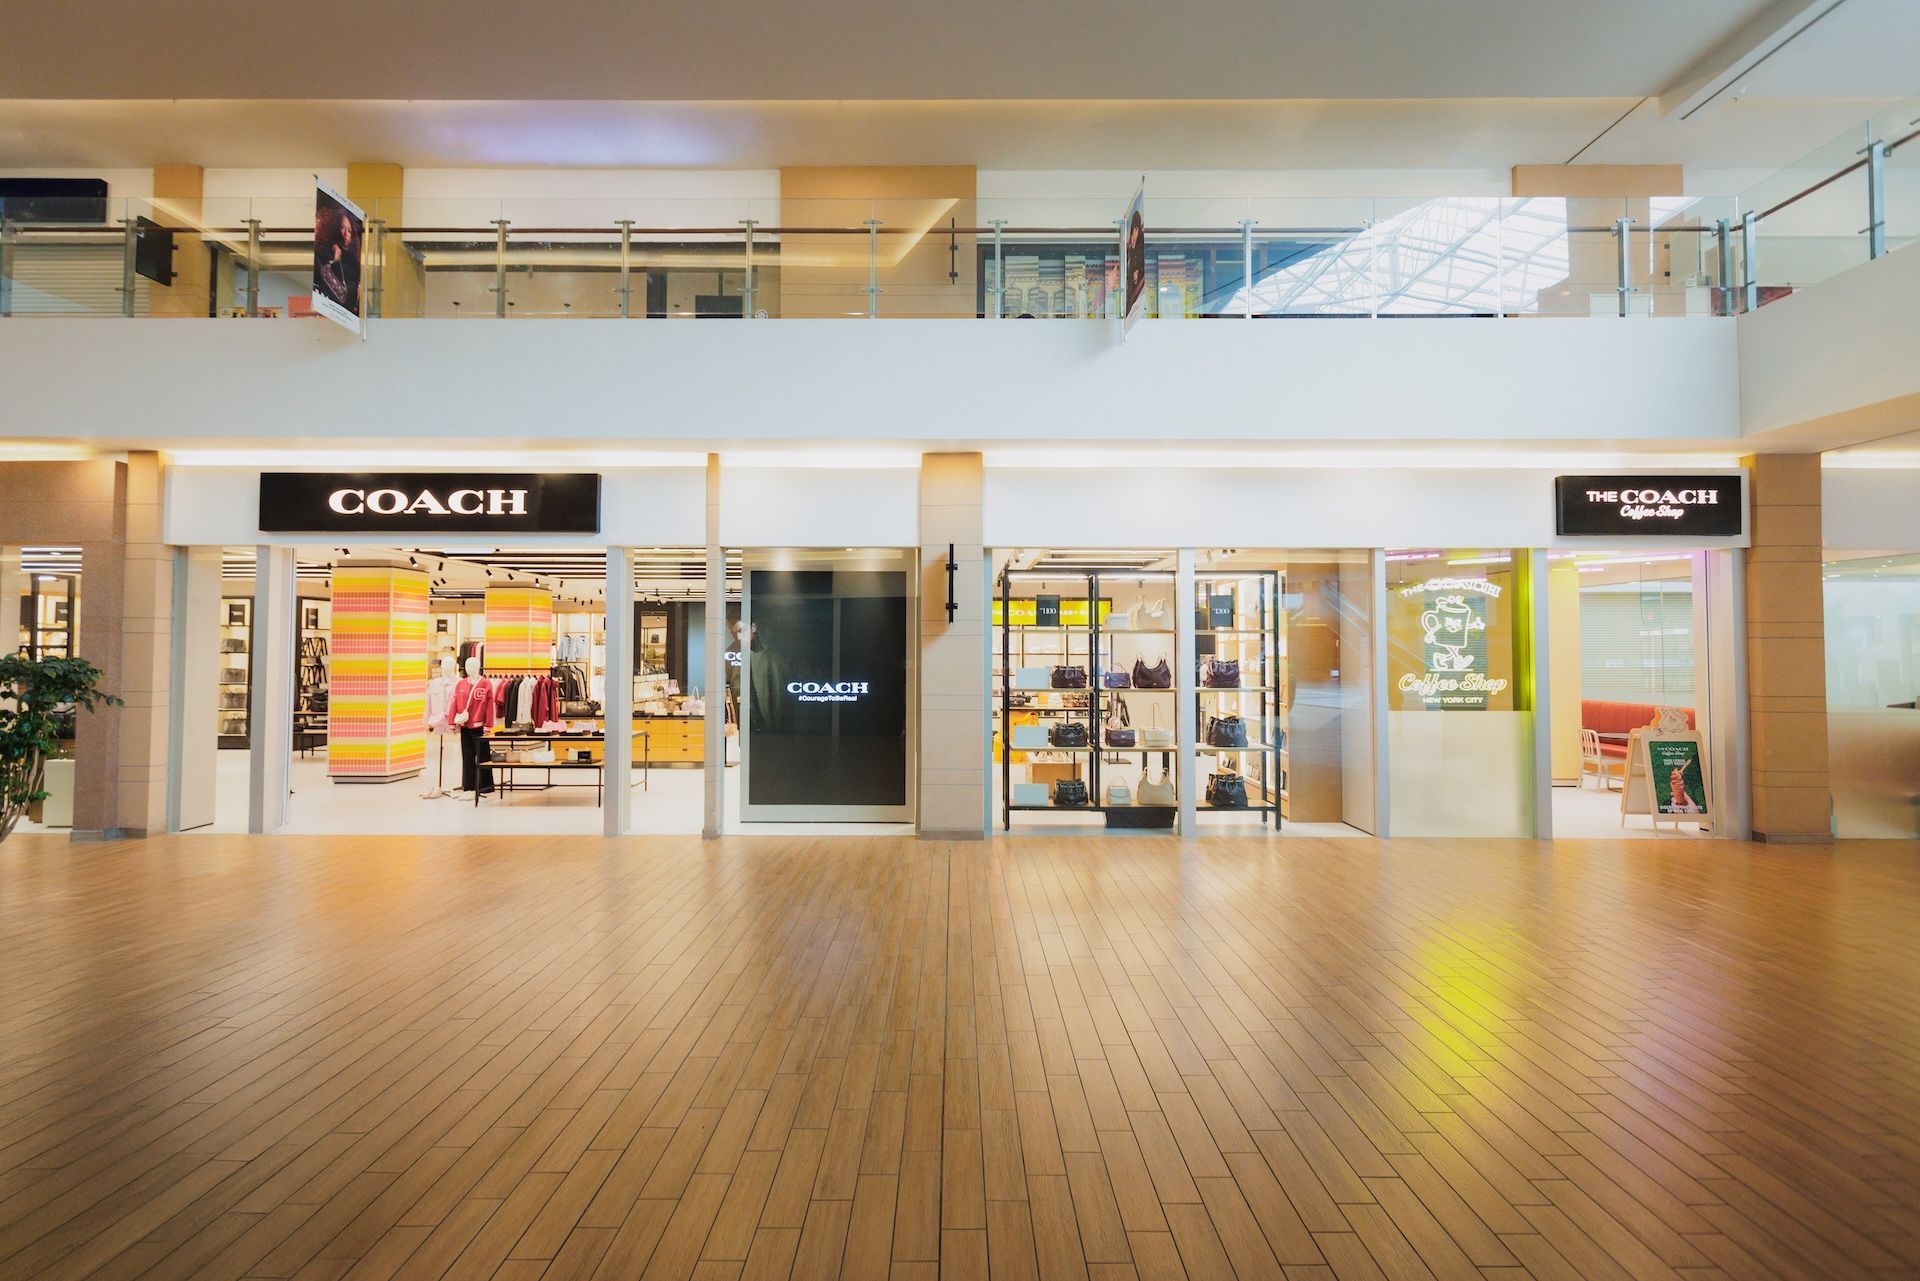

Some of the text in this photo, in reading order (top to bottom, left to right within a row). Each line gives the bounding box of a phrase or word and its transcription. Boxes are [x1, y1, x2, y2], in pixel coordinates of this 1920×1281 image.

[328, 489, 528, 515] COACH
[1586, 489, 1719, 505] THE COACH
[1619, 505, 1684, 520] Coffee Shop
[1400, 583, 1425, 598] THE
[786, 682, 869, 694] COACH
[1398, 673, 1508, 696] Coffee Shop
[798, 695, 858, 703] #CourageToBeReal
[1442, 696, 1465, 704] YORK
[1464, 696, 1484, 704] CITY
